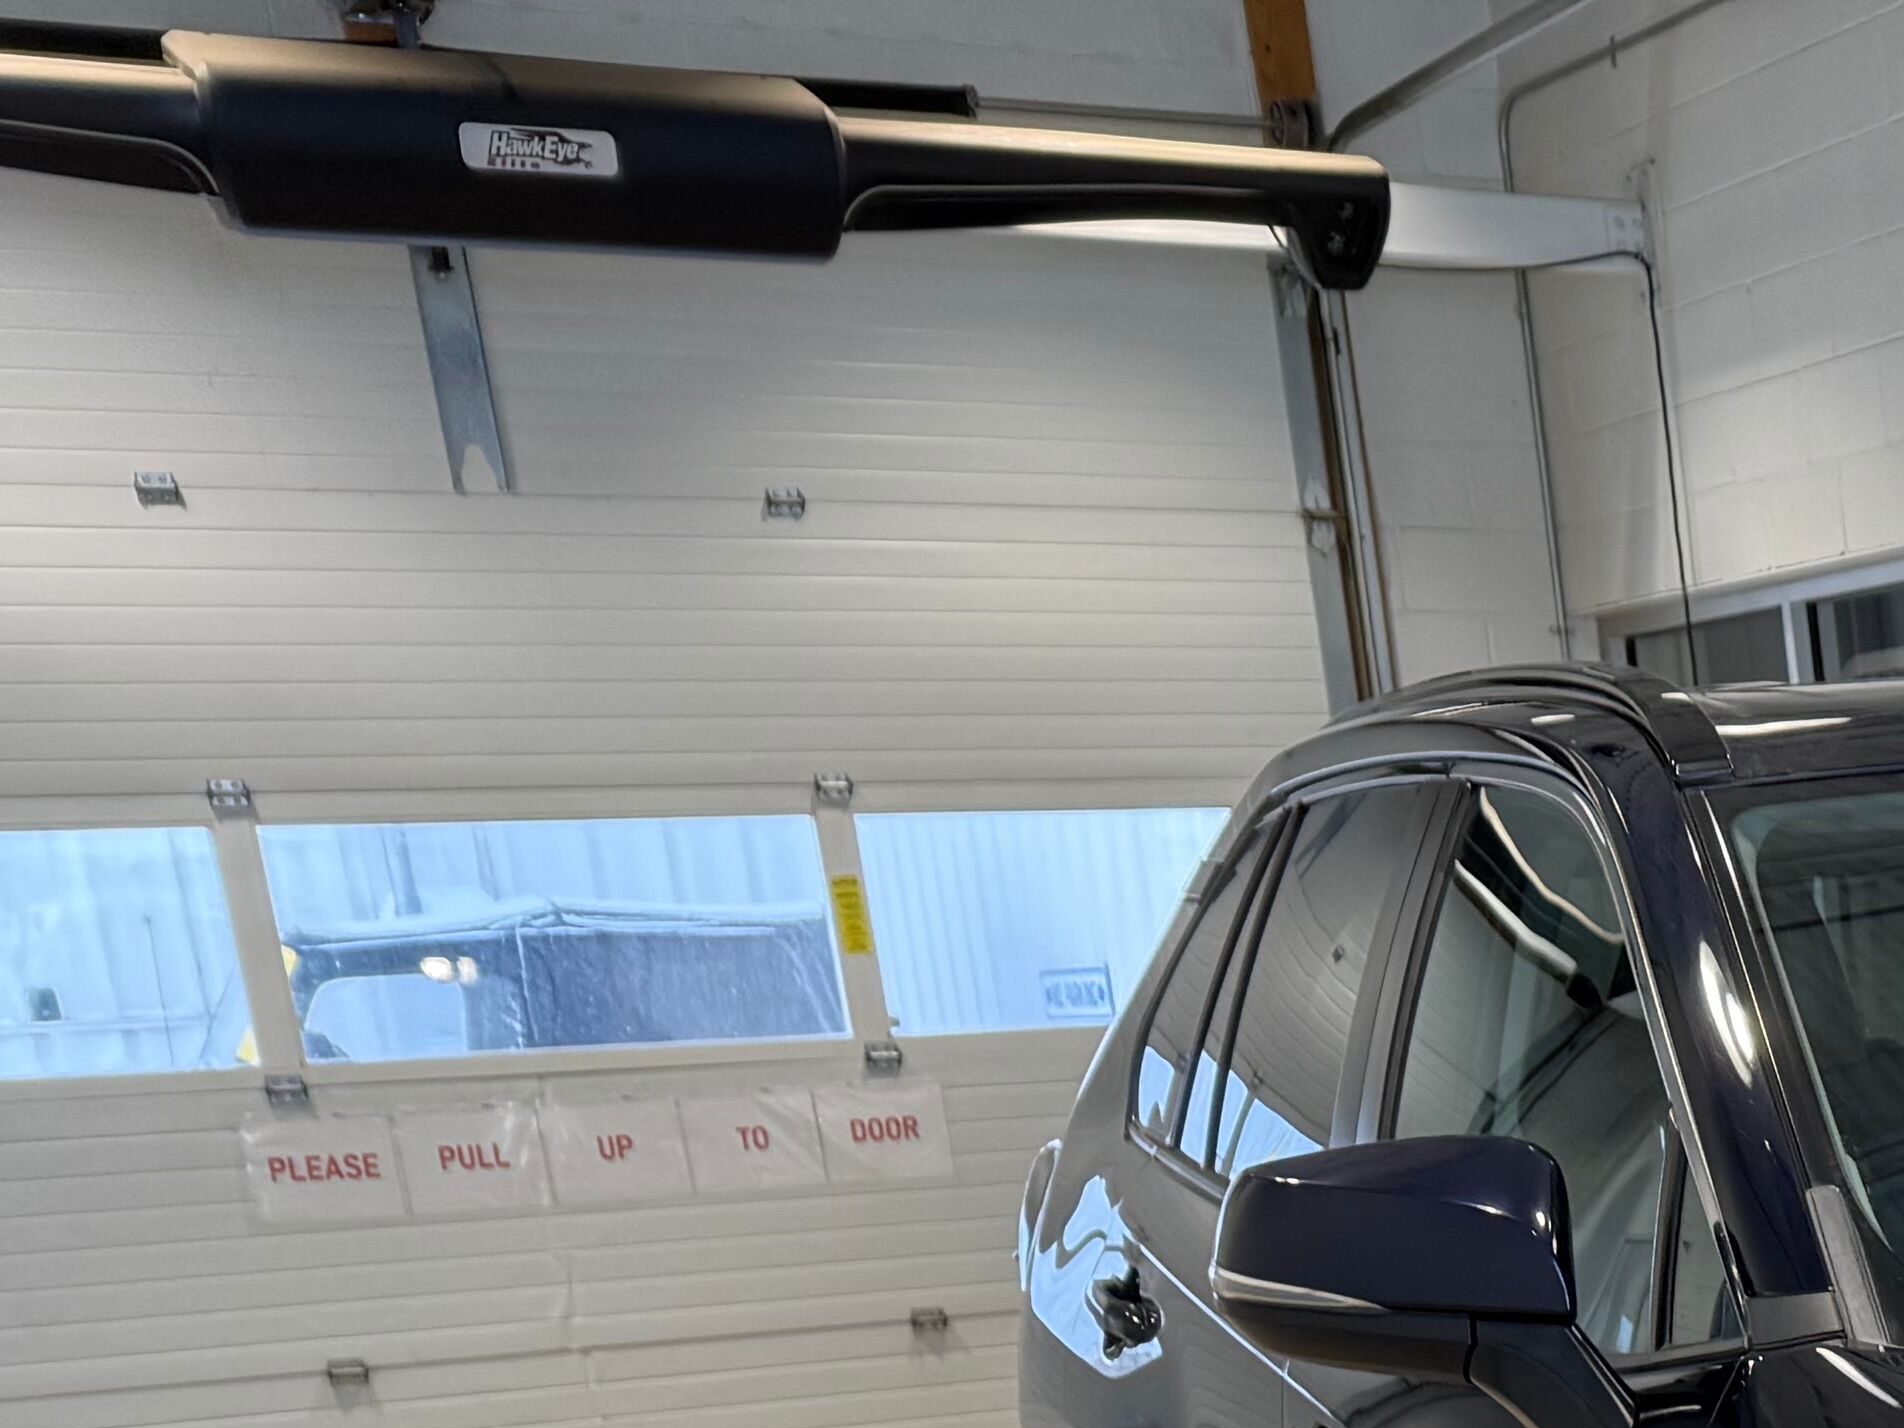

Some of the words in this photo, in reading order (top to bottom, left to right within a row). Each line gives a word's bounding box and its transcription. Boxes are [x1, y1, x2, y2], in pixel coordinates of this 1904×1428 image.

[490, 130, 579, 162] HawkEye
[267, 1152, 382, 1183] PLEASE
[437, 1141, 512, 1171] PULL
[596, 1133, 634, 1161] UP
[735, 1124, 770, 1151] TO
[849, 1114, 921, 1144] DOOR
